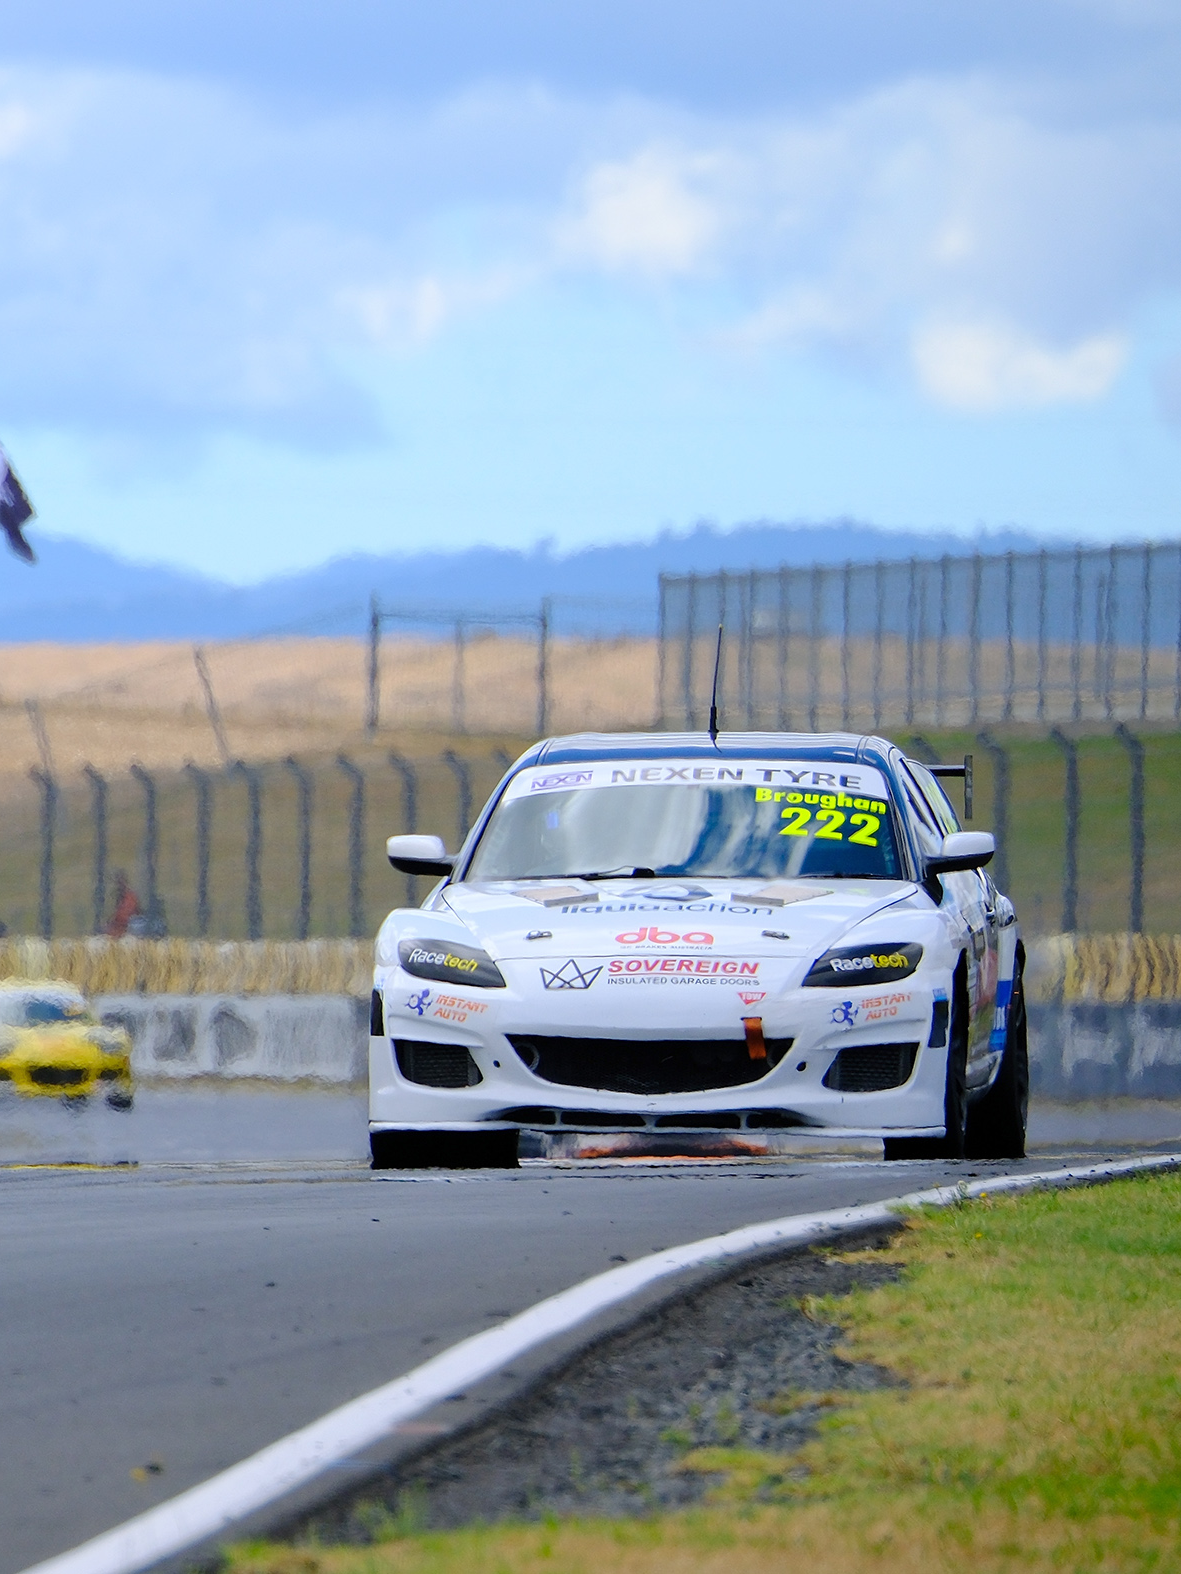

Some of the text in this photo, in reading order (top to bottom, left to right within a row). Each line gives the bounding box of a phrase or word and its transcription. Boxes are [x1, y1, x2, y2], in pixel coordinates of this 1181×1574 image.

[611, 766, 862, 790] NEXEN TYRE
[755, 787, 887, 816] Broughan
[778, 807, 881, 848] 222
[615, 926, 714, 945] dba
[408, 948, 479, 973] Racetech
[607, 959, 760, 975] SOVEREIGN
[829, 951, 909, 972] Racetech
[607, 976, 761, 987] INSULATED GARAGE DOORS
[436, 994, 488, 1014] INSTANT
[865, 1006, 898, 1021] AUTO
[433, 1008, 468, 1023] AUTO
